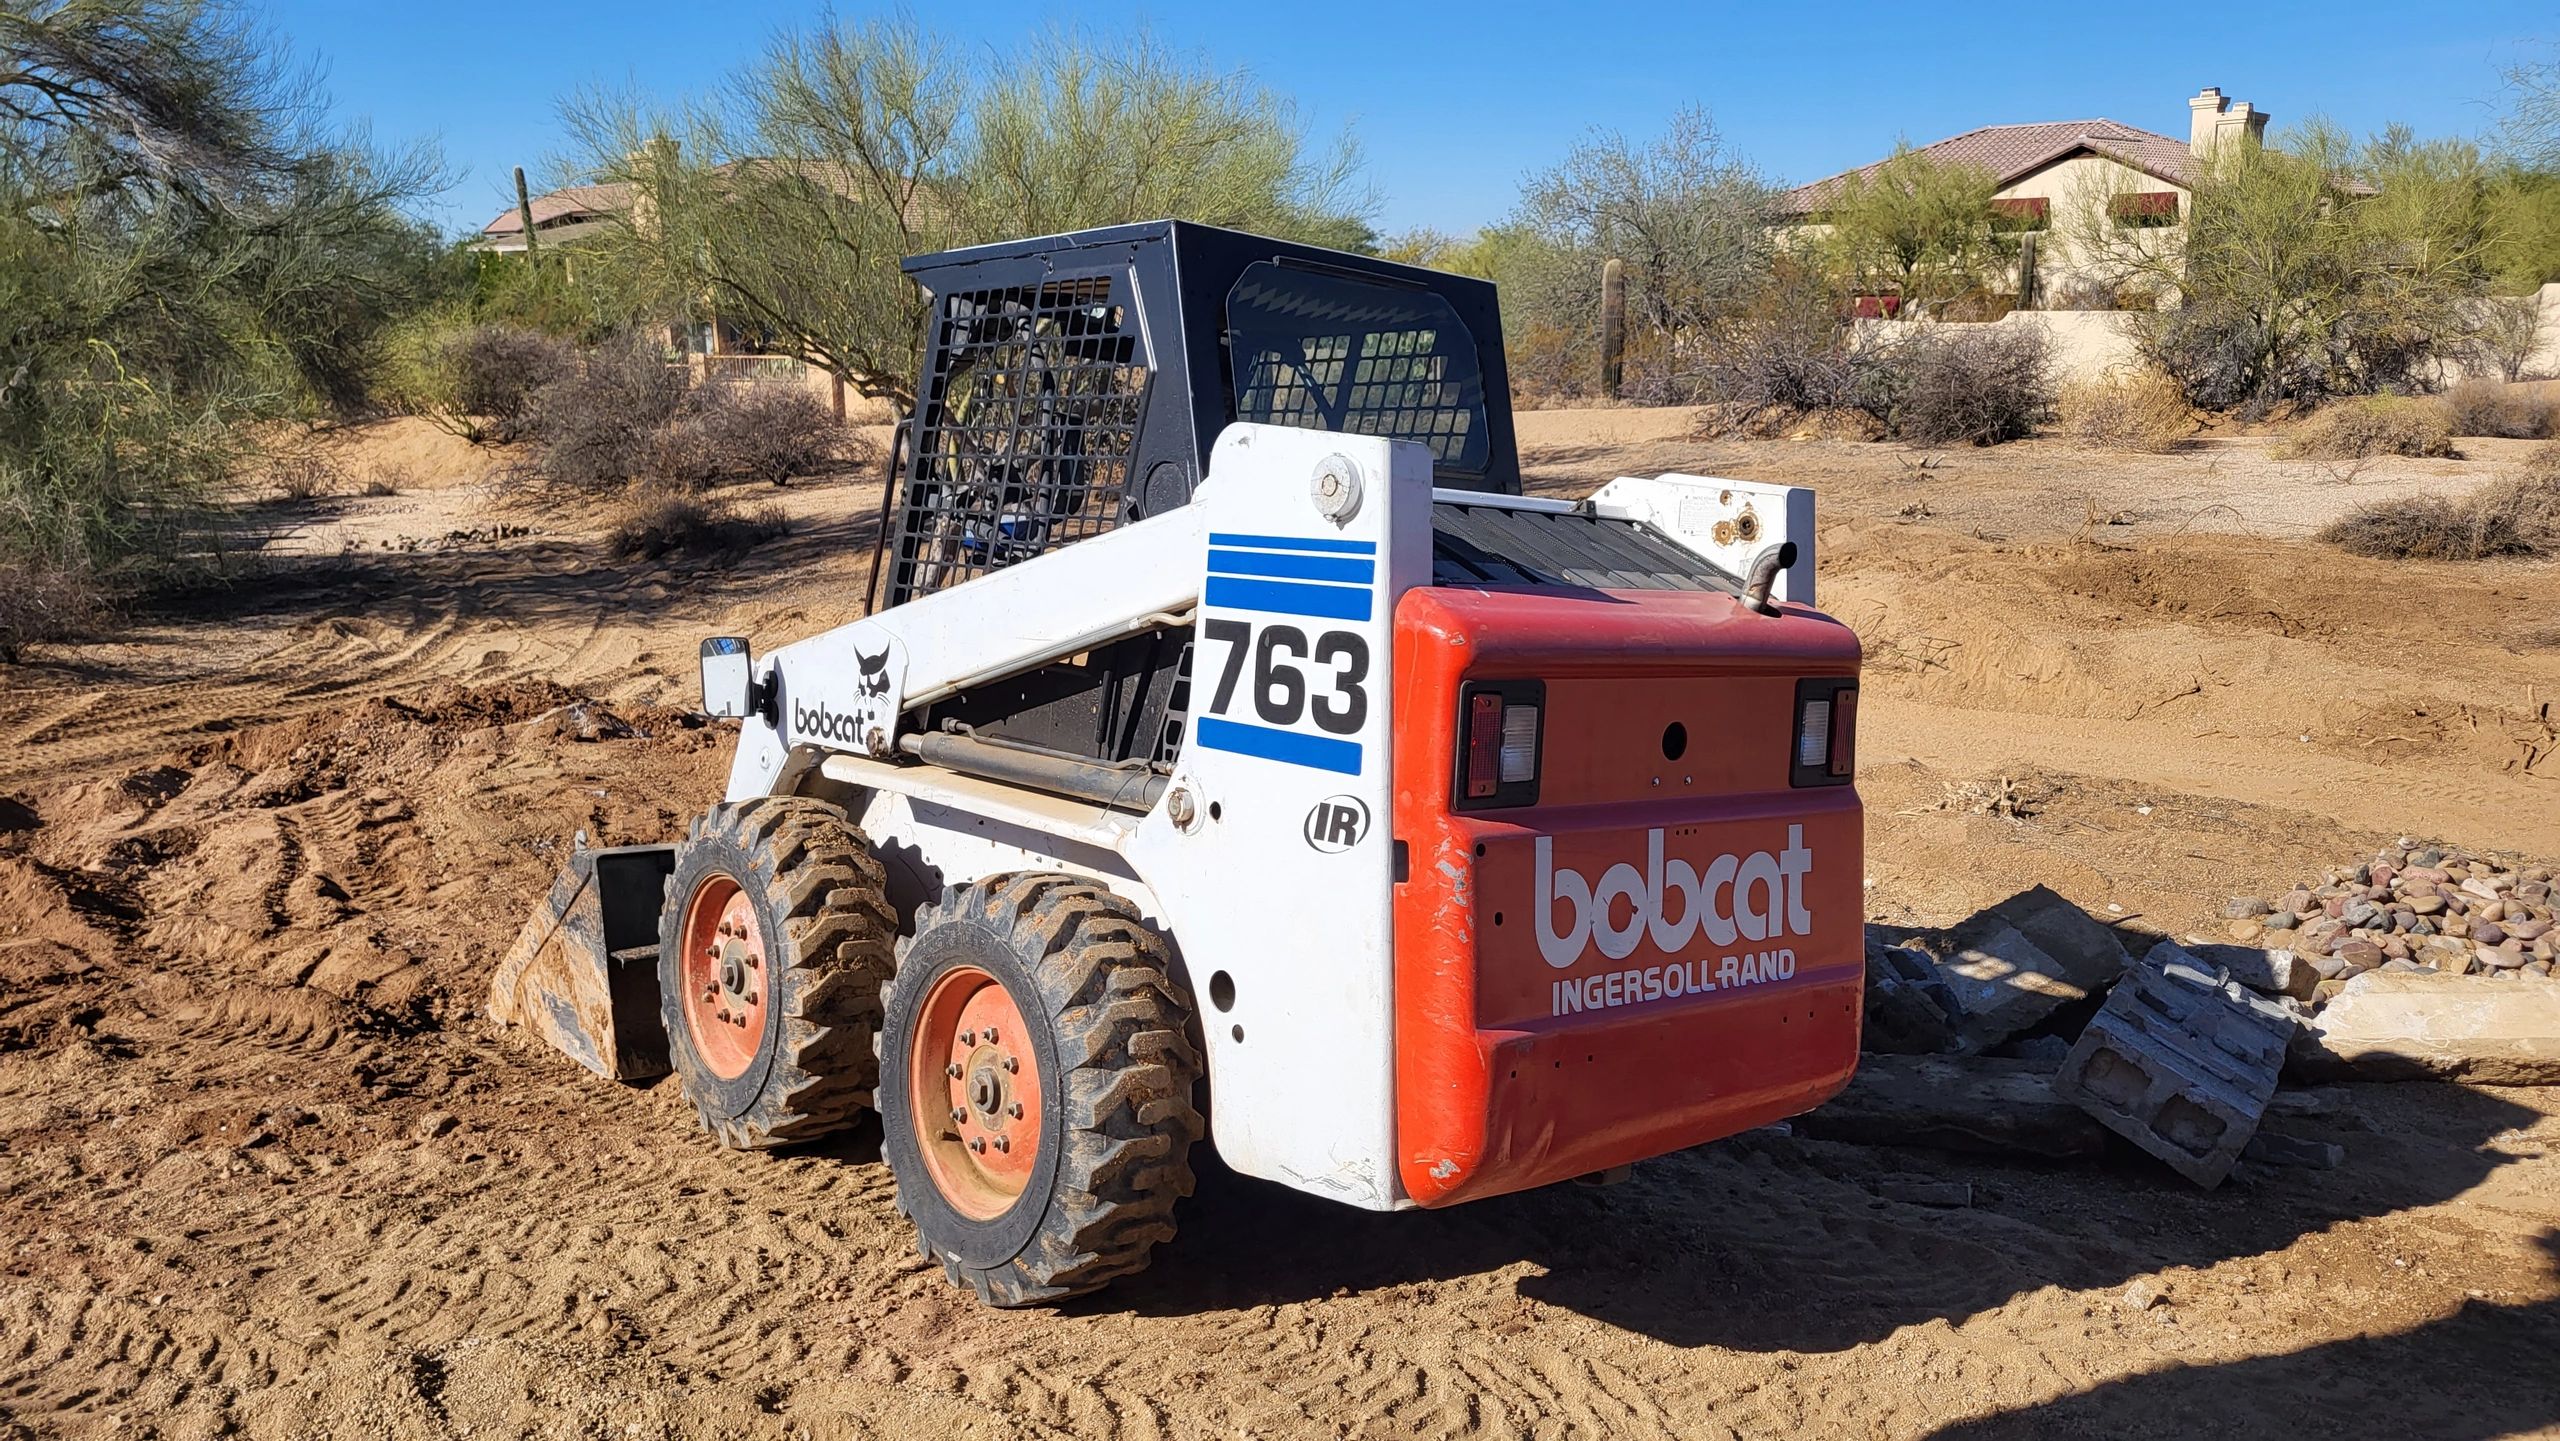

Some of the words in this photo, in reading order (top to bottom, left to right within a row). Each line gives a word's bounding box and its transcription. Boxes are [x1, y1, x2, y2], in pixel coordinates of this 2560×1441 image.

[1204, 618, 1370, 735] 763
[795, 697, 864, 746] bobcat
[1313, 802, 1360, 847] IR
[1535, 824, 1812, 969] bobcat
[1552, 949, 1796, 1016] INGERSOLL-RAND
